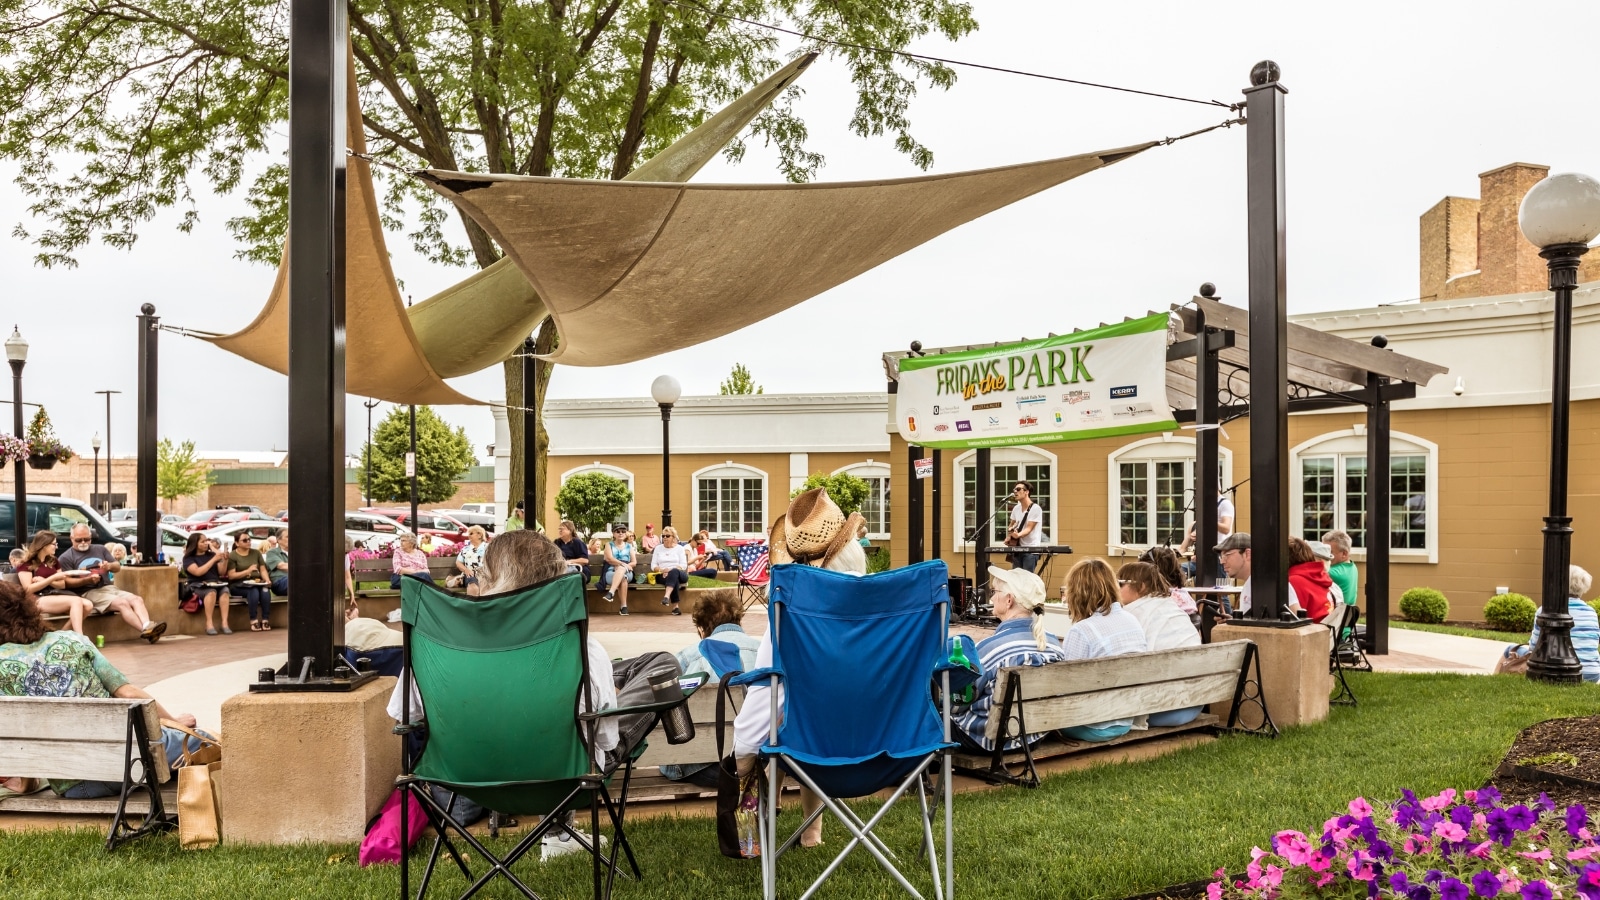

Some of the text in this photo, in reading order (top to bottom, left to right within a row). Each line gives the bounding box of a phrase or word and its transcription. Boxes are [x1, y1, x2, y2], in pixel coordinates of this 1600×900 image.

[936, 359, 1000, 396] FRIDAYS
[1007, 344, 1094, 392] PARK
[962, 374, 1006, 401] in the
[1112, 387, 1136, 395] KERRY
